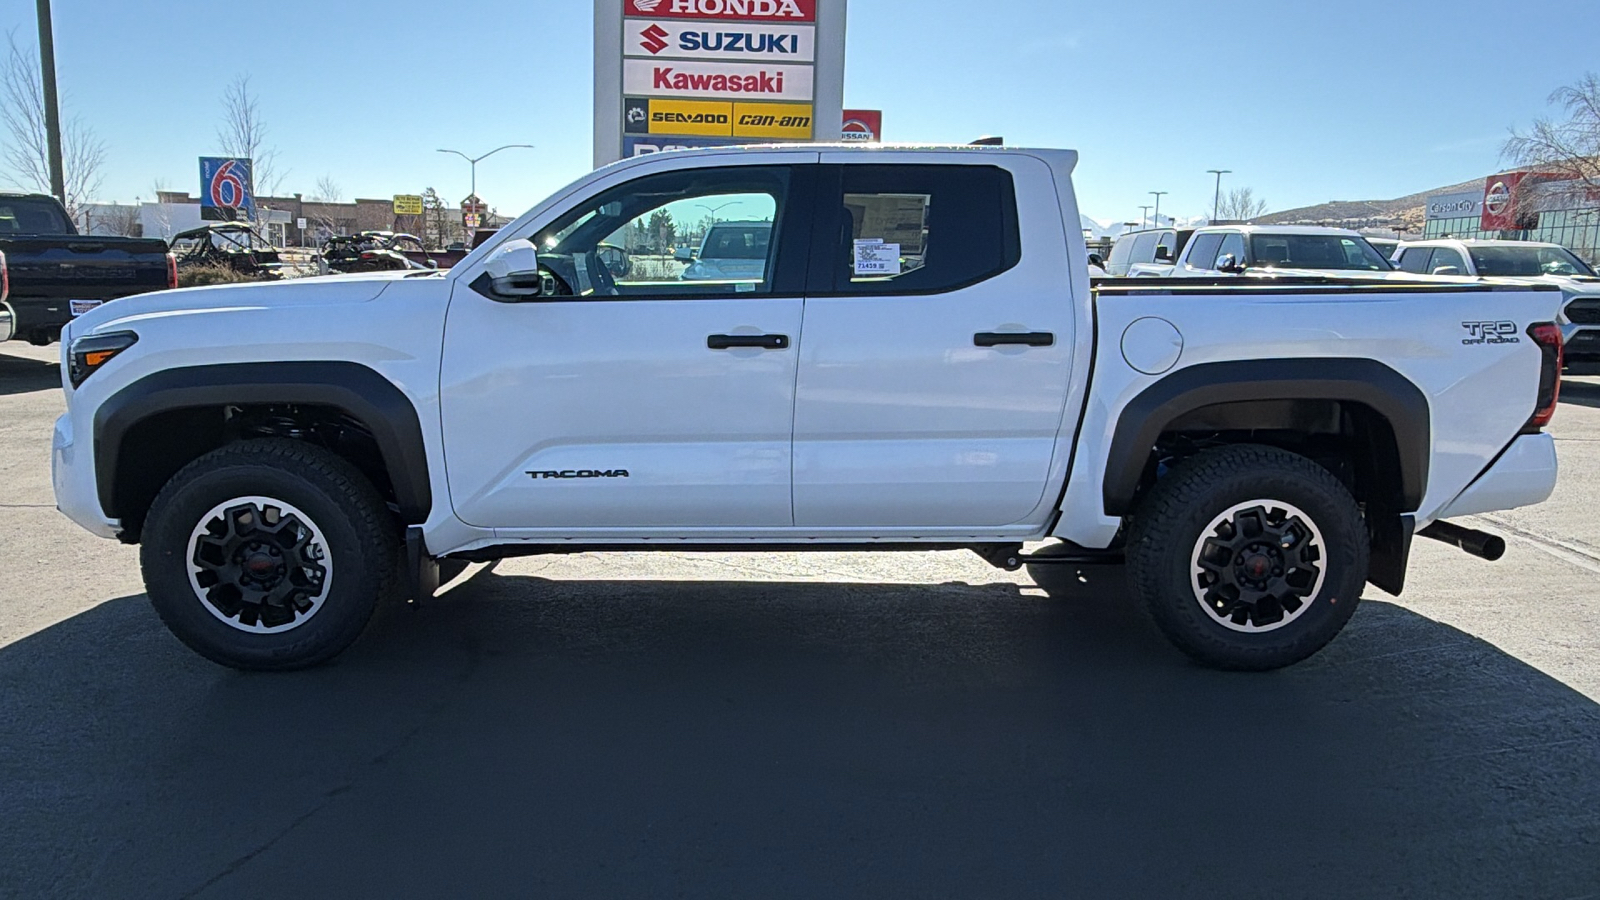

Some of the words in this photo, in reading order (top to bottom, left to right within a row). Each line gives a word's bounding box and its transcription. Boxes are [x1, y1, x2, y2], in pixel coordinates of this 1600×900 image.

[669, 0, 804, 17] HONDA
[679, 31, 798, 53] SUZUKI
[653, 67, 783, 93] Kawasaki
[738, 114, 810, 128] can-am
[211, 160, 244, 208] 6
[1430, 202, 1456, 213] Carson
[1457, 200, 1476, 212] City
[1462, 320, 1517, 339] TRD
[525, 469, 629, 479] TACOMA
